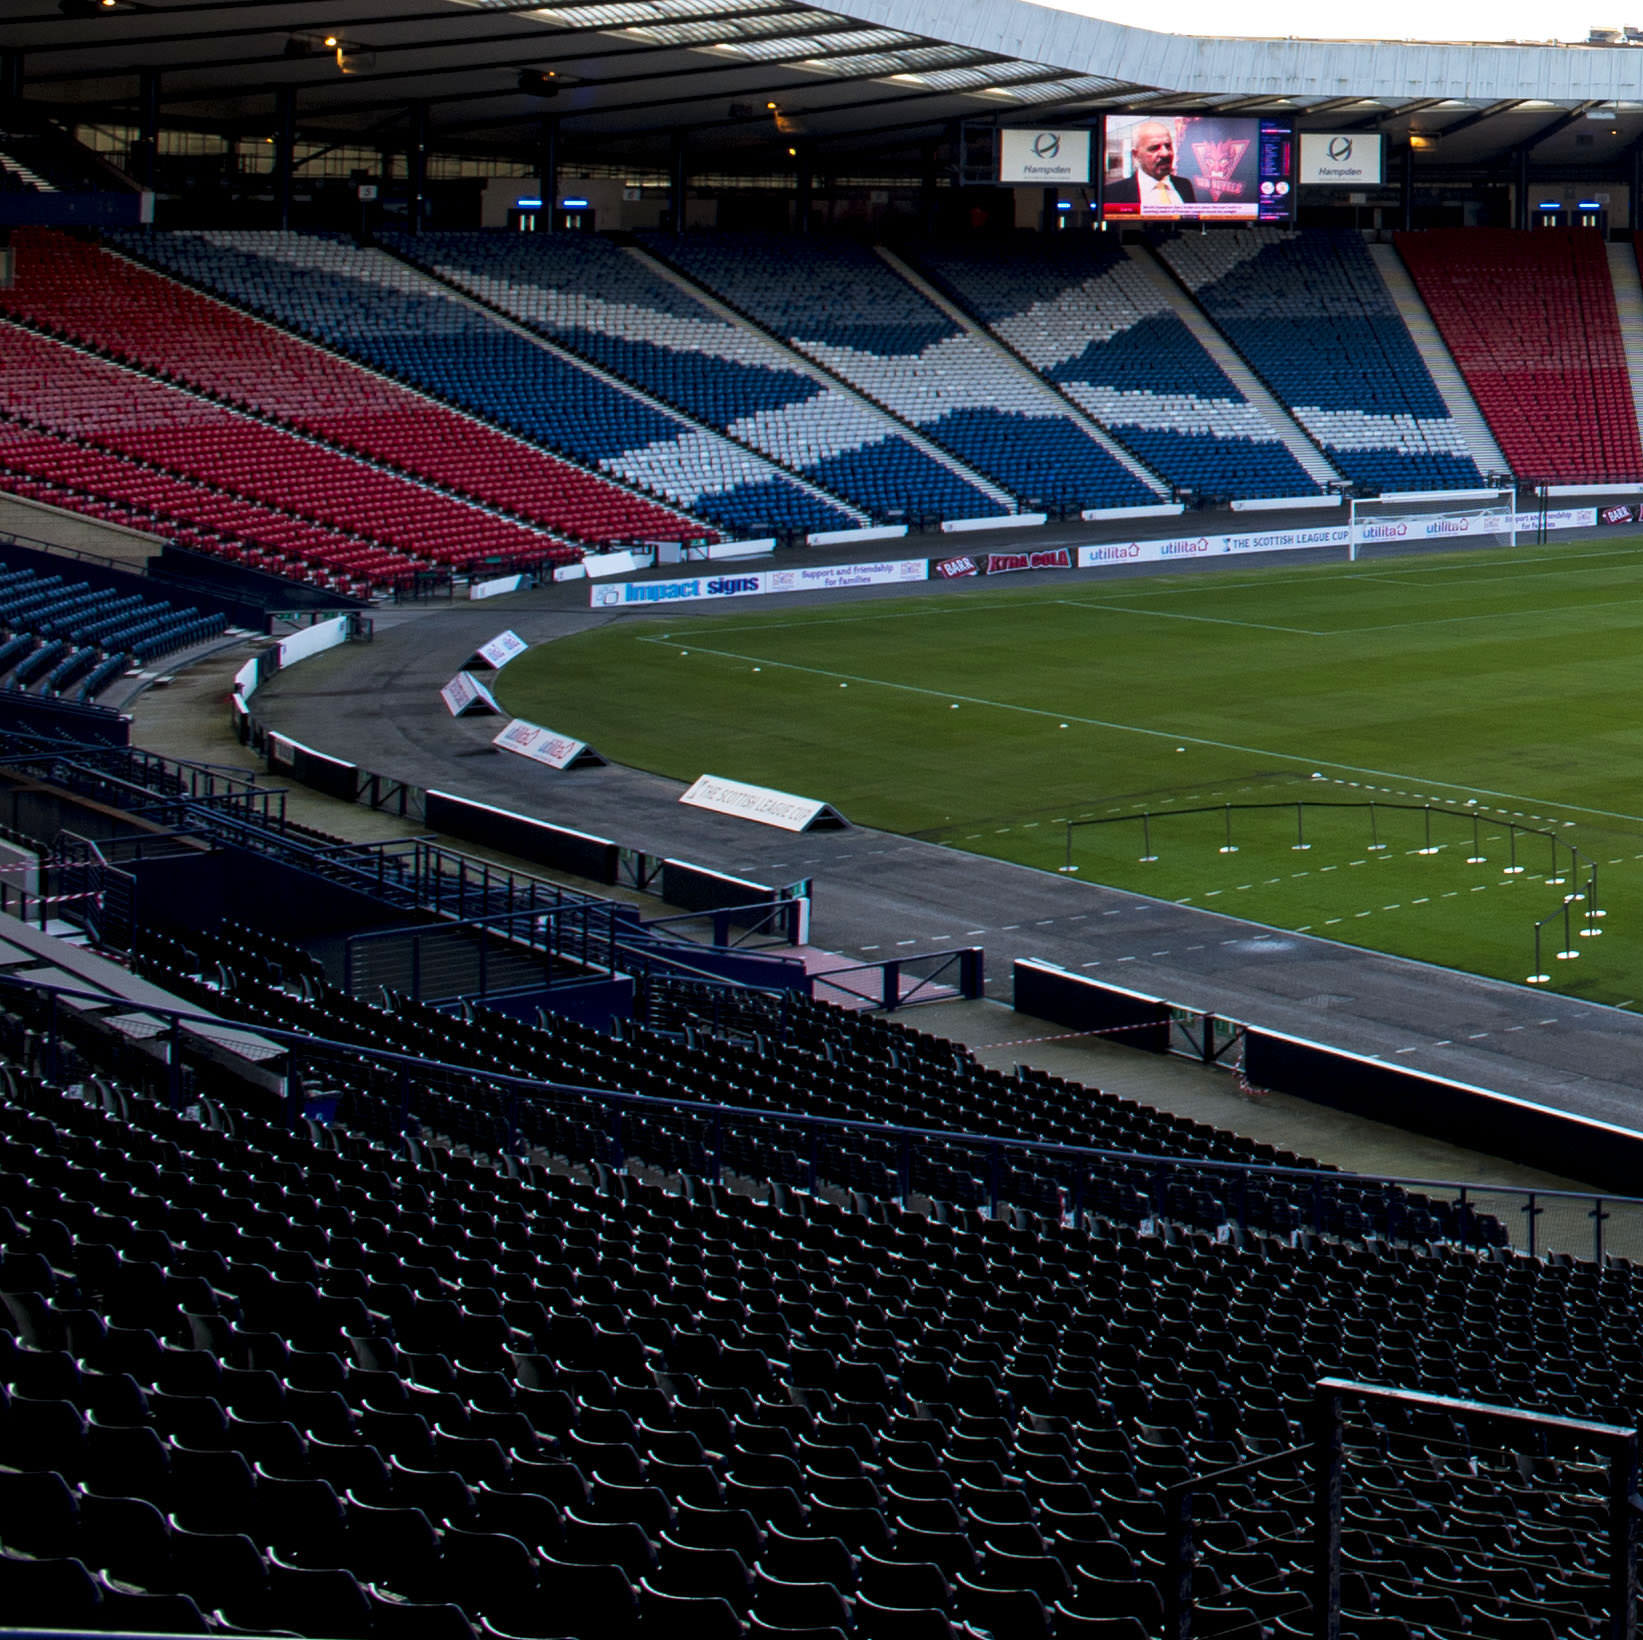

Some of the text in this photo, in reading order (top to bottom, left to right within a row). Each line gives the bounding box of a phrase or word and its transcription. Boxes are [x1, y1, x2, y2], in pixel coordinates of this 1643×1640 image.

[1318, 167, 1362, 177] Hampden
[1363, 523, 1397, 538] utilita
[1426, 519, 1459, 533] utilita
[1161, 541, 1197, 555] utilita
[1233, 531, 1349, 549] THE SCOTTISH LEAGUE CUP
[1031, 549, 1070, 568] COLA
[1089, 545, 1128, 561] utilita
[801, 568, 836, 580] Support
[837, 566, 852, 575] and
[853, 563, 894, 575] friendship
[944, 557, 973, 576] BARR
[707, 577, 759, 595] signs
[824, 574, 872, 586] for families
